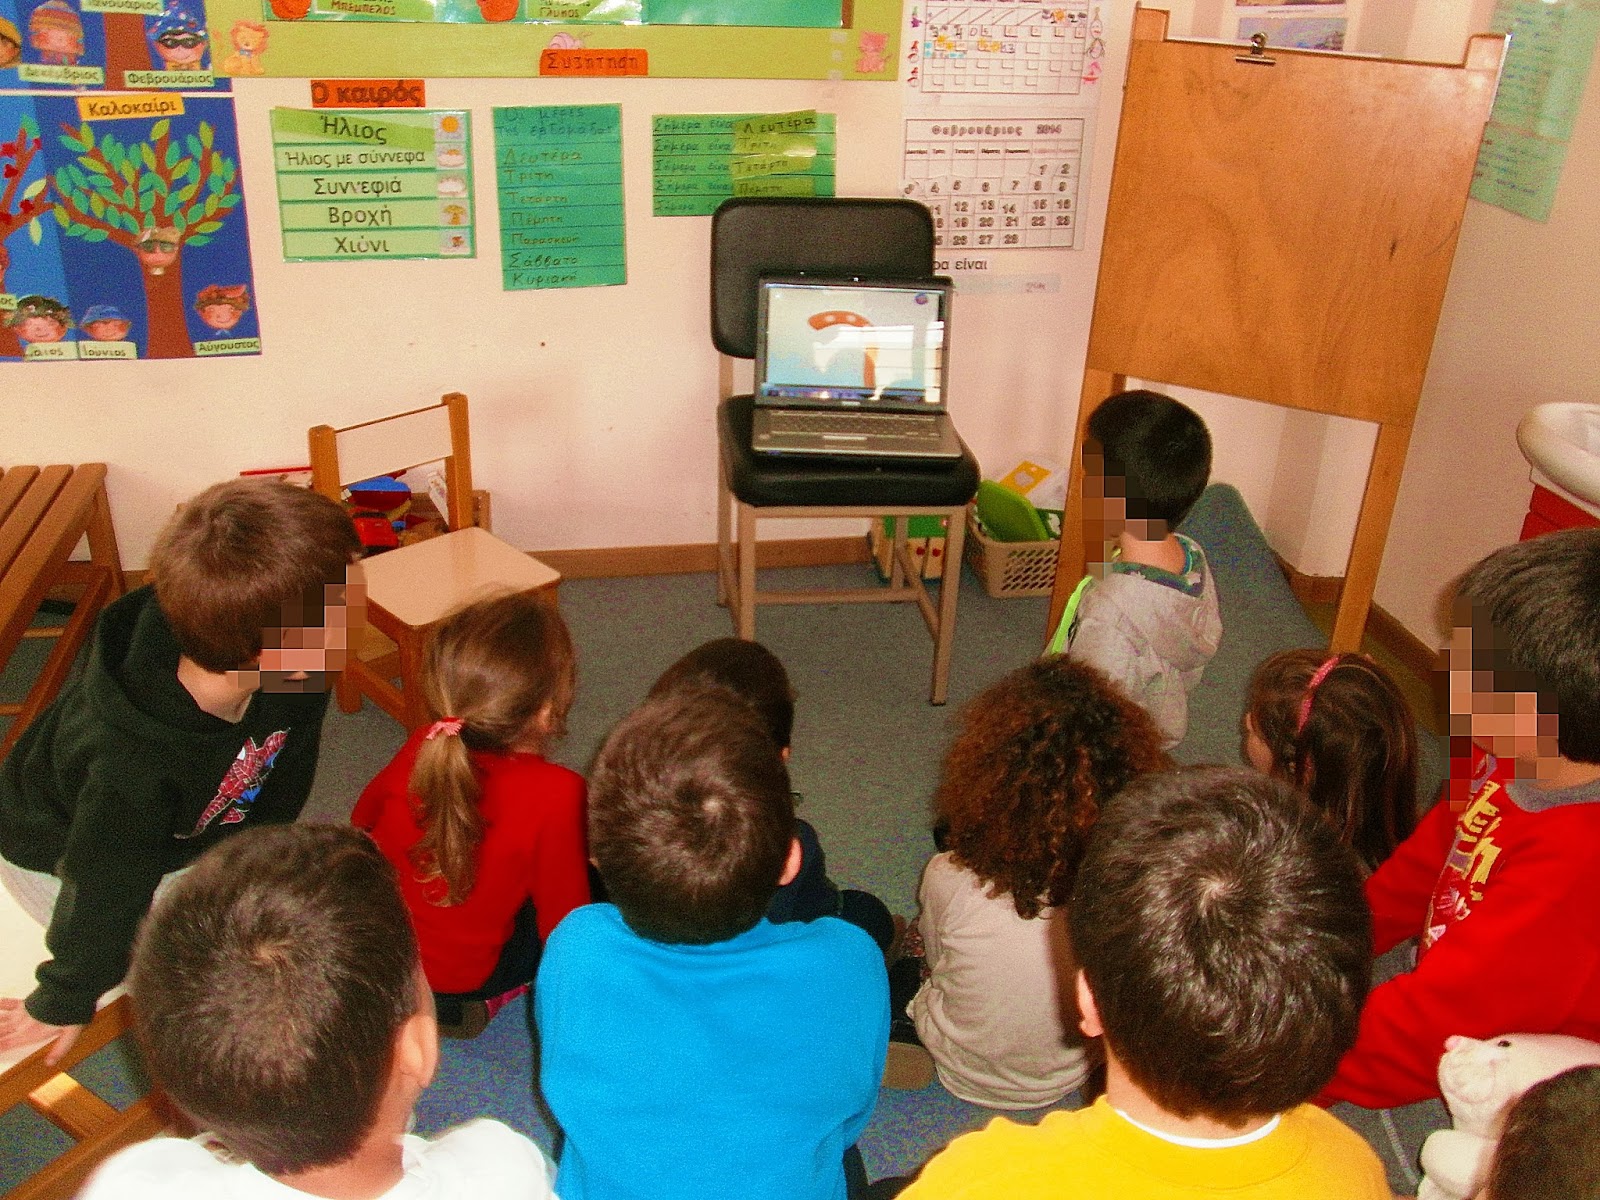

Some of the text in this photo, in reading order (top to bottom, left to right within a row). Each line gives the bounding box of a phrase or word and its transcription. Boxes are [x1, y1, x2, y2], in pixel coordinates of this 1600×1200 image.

[128, 72, 212, 85] Φεβρουάριος
[311, 80, 421, 107] Ο καιρός
[89, 97, 177, 116] Καλοκαίρι
[321, 115, 387, 145] Ήλιος
[285, 150, 426, 168] Ήλιος με σύννεφα
[1060, 163, 1070, 174] 2
[313, 176, 402, 196] Συννεφιά
[1012, 180, 1020, 190] 7
[954, 201, 969, 212] 12
[1002, 204, 1017, 214] 14
[328, 205, 391, 226] Βροχή
[1006, 216, 1019, 227] 21
[1031, 216, 1046, 226] 22
[335, 236, 389, 253] Χιόνι
[979, 234, 994, 245] 27
[955, 258, 988, 270] είναι
